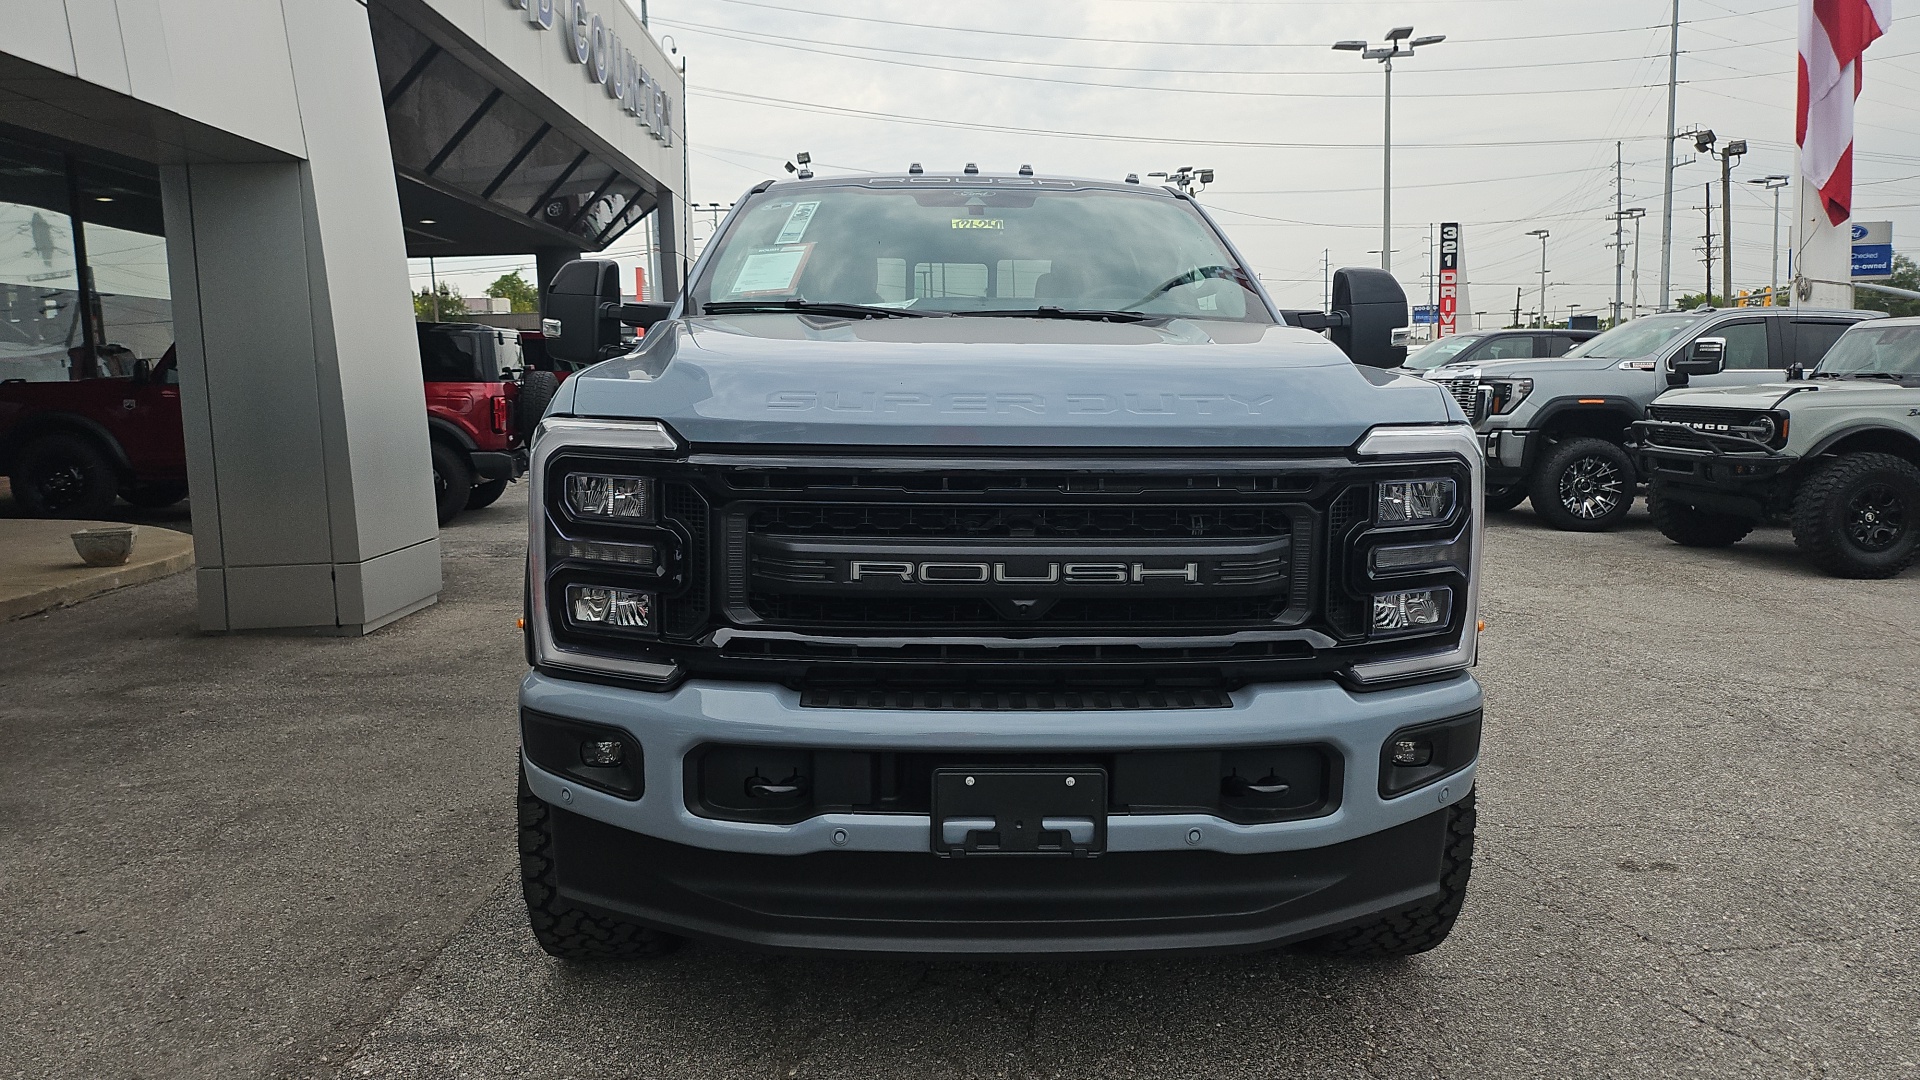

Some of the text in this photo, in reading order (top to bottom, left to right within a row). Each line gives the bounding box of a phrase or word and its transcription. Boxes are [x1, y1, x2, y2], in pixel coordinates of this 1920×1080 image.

[566, 0, 673, 148] COUNTRY
[1442, 226, 1457, 267] 321
[1440, 272, 1456, 336] DRIVE
[766, 390, 1274, 414] SUPER DUTY
[850, 560, 1199, 584] ROUSH
